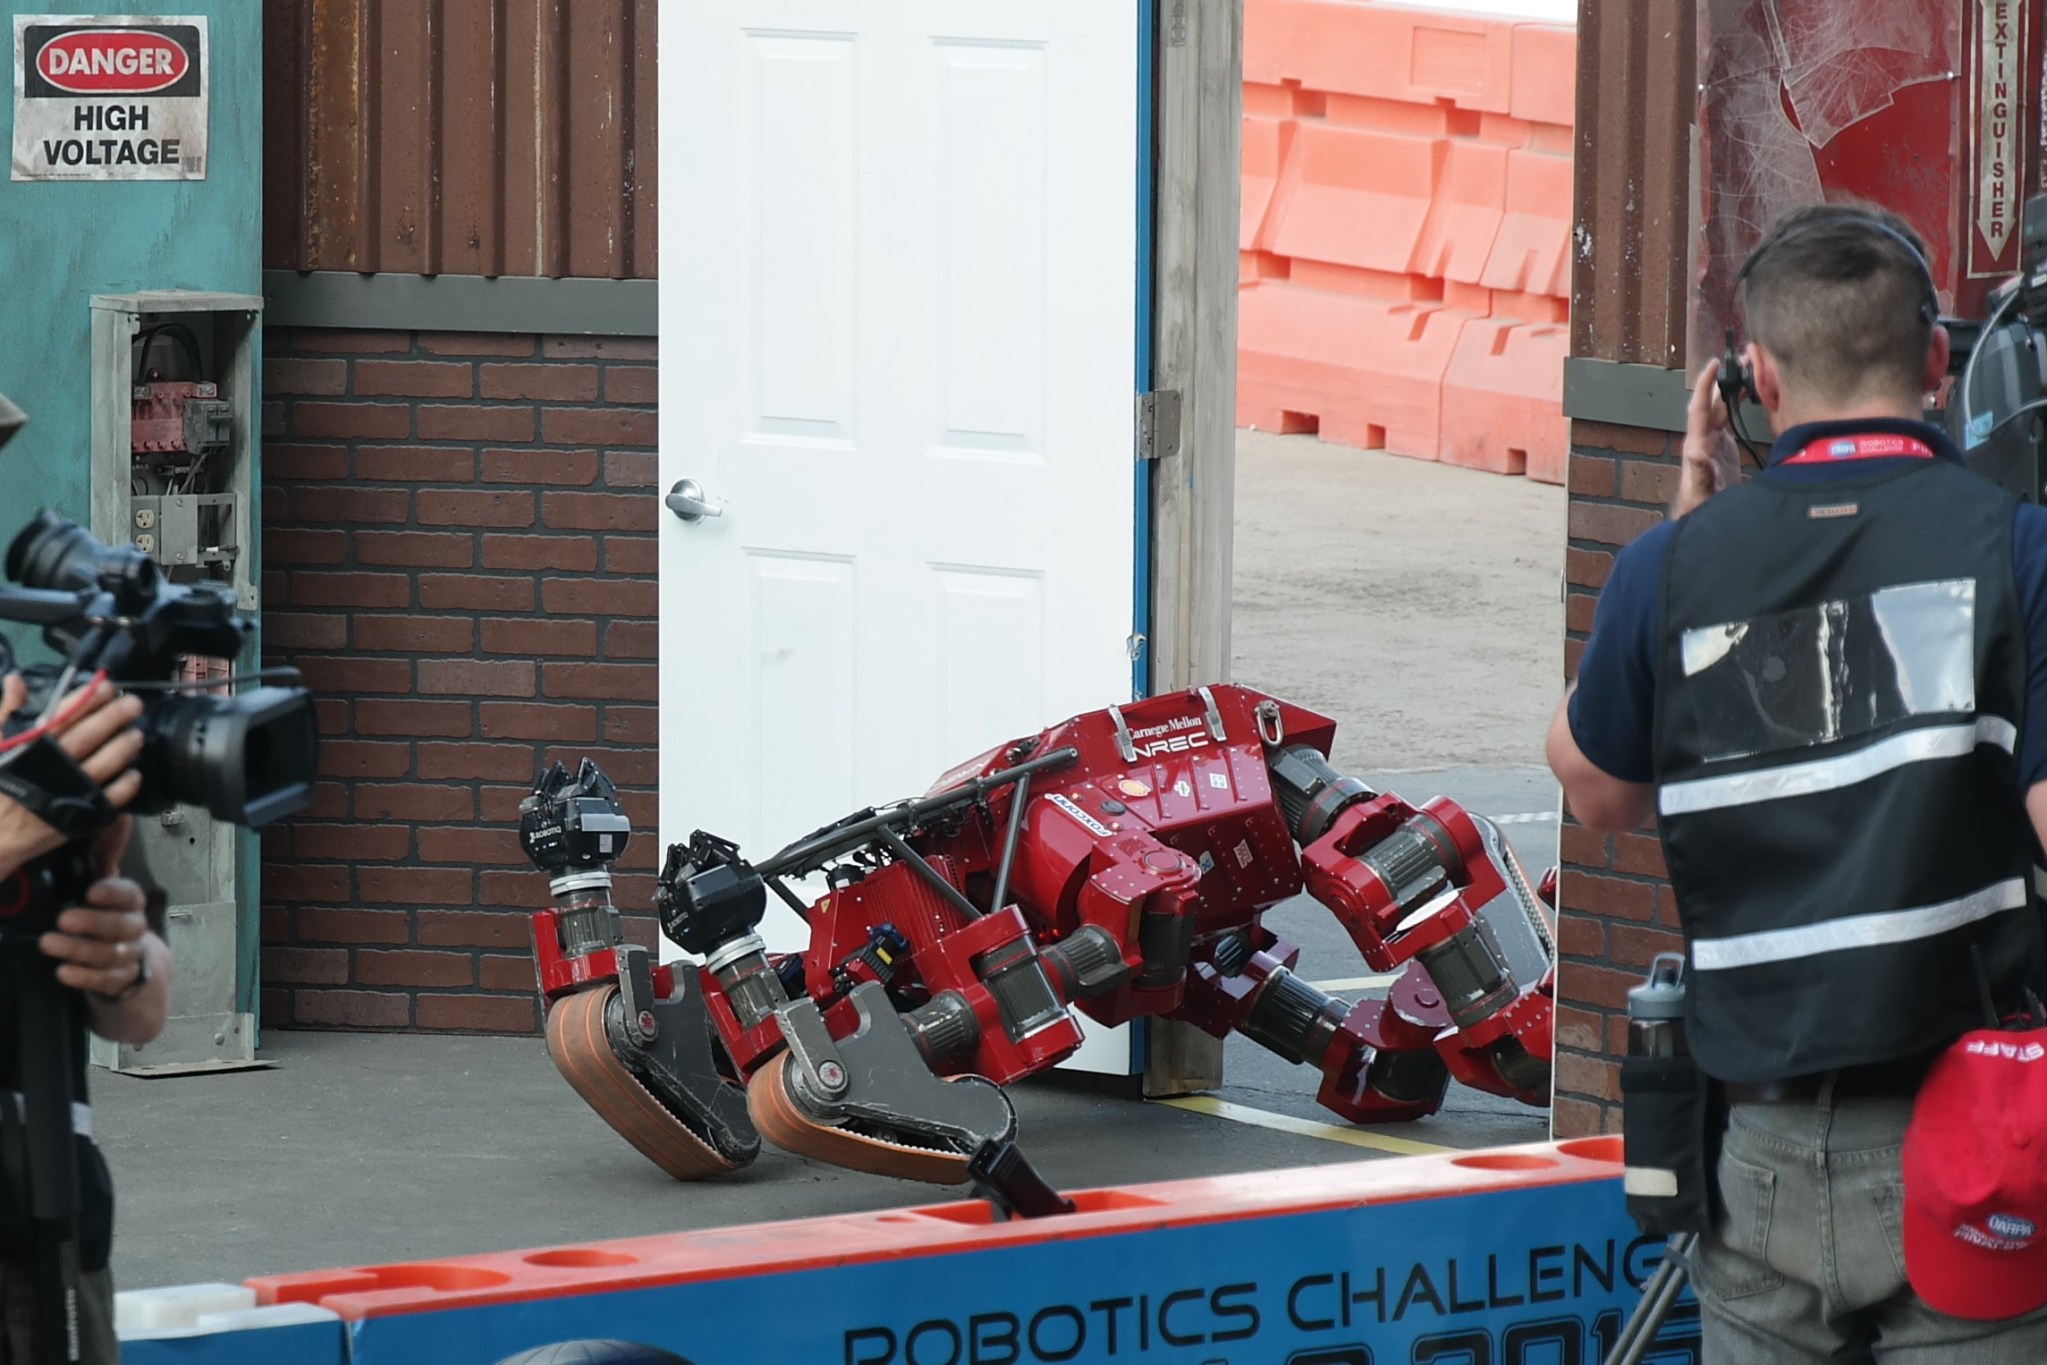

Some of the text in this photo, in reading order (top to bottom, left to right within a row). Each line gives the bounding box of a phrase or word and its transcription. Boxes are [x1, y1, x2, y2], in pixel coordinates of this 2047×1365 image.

[49, 48, 174, 75] DANGER
[74, 105, 149, 131] HIGH
[1990, 2, 2008, 238] EXTINGUISHER
[44, 139, 180, 165] VOLTAGE
[1168, 716, 1202, 732] Mellon
[1131, 731, 1209, 757] NREC
[1966, 1040, 2045, 1062] STAFF
[1988, 1215, 2035, 1237] DARPA
[844, 1234, 1668, 1365] ROBOTICS CHALLENG
